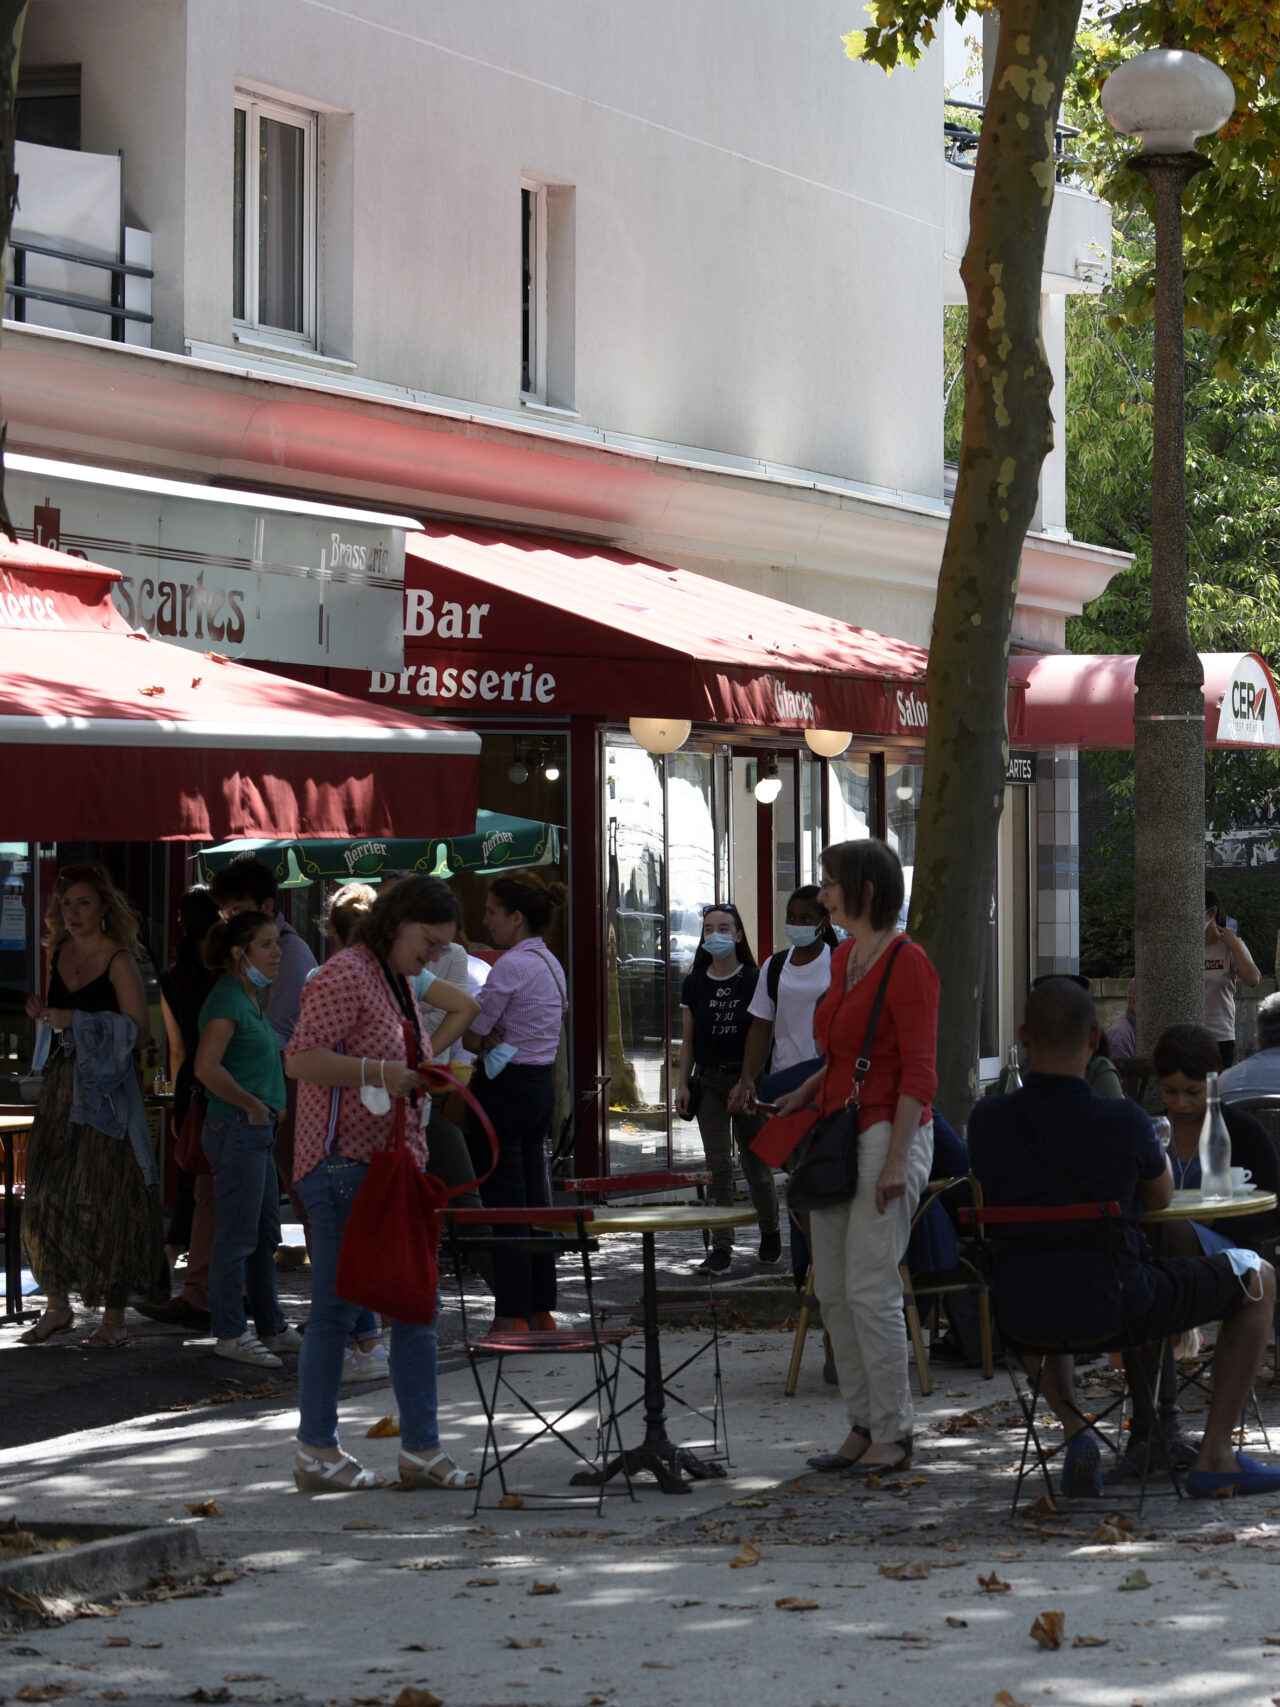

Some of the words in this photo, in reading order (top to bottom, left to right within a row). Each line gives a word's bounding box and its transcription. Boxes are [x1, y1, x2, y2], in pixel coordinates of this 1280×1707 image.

[330, 532, 389, 574] Brasserie
[84, 556, 245, 643] scartes
[404, 588, 490, 639] Bar
[368, 663, 557, 703] Brasserie
[774, 679, 815, 721] Glaces
[1006, 758, 1032, 779] ARTES
